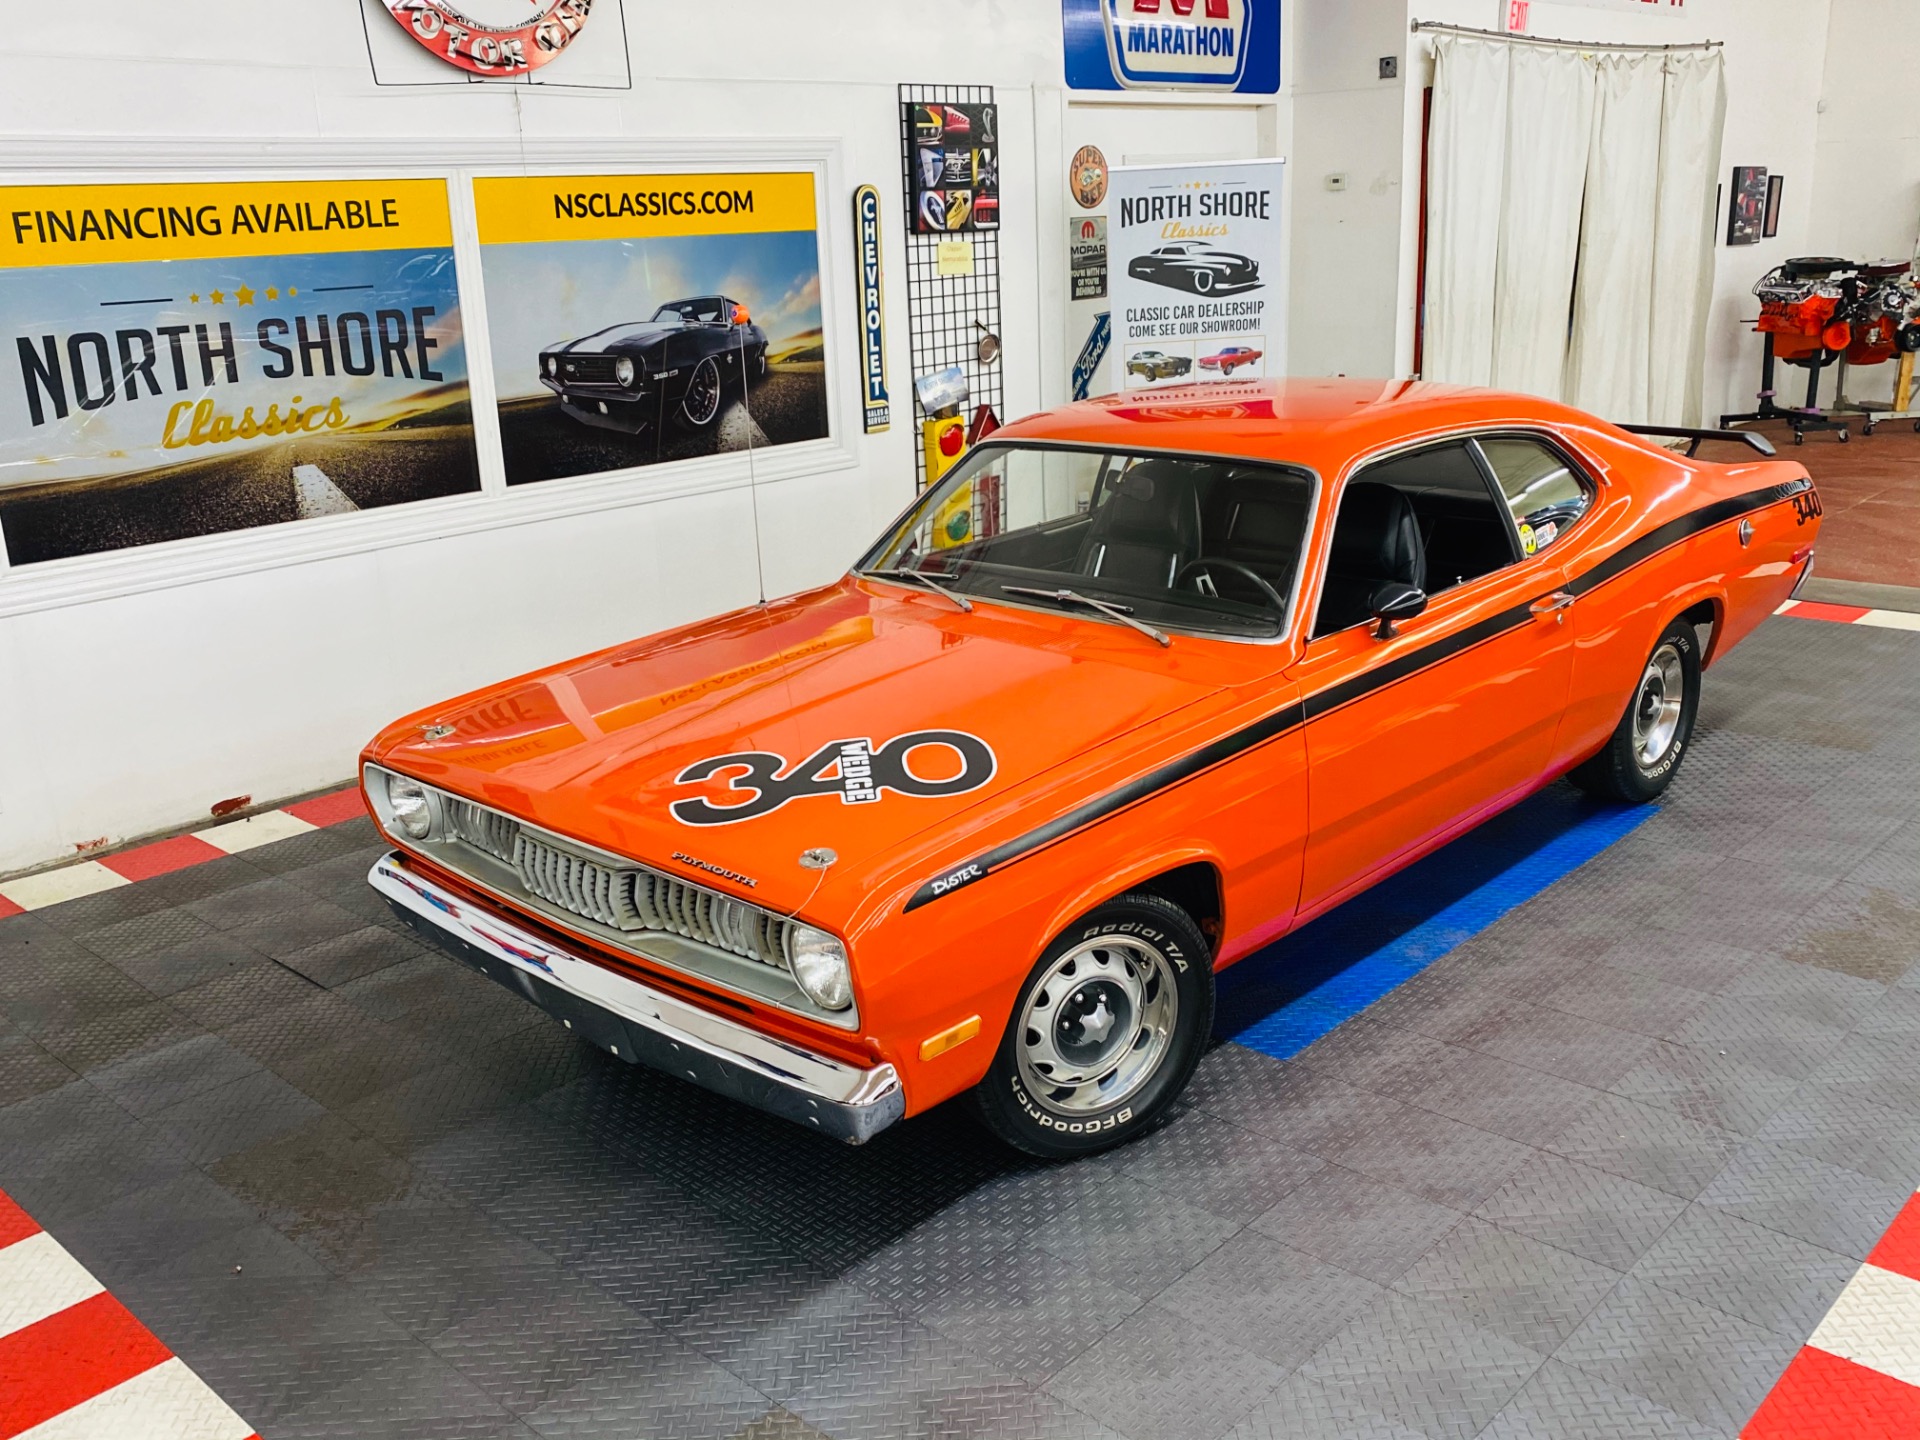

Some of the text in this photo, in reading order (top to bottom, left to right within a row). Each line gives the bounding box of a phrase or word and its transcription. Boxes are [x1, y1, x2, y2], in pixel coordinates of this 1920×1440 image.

[1509, 1, 1529, 31] EXIT
[1128, 23, 1234, 57] MARATHON
[1073, 150, 1104, 182] SUPER
[12, 199, 399, 244] FINANCING AVAILABLE
[554, 190, 754, 219] NSCLASSICS.COM
[1121, 190, 1270, 228] NORTH SHORE
[1161, 221, 1229, 239] Classics
[1071, 245, 1106, 256] MOPAR
[1086, 267, 1100, 277] WITH
[863, 197, 881, 396] CHEVROLET
[1126, 301, 1265, 322] CLASSIC CAR DEALERSHIP
[1129, 318, 1261, 338] COME SEE OUR SHOWROOM!
[16, 306, 444, 427] NORTH SHORE
[1081, 333, 1104, 379] Ford
[161, 395, 351, 449] Classics
[867, 408, 884, 418] SALES
[867, 415, 889, 425] SERVICE
[1793, 491, 1822, 526] 340
[669, 729, 997, 827] 340
[841, 741, 877, 802] WEDGE
[671, 851, 758, 889] PLYMOUTH
[932, 864, 982, 896] DUSTER
[1083, 922, 1190, 974] Radial T/A
[1011, 1076, 1133, 1134] BFGoodrich
